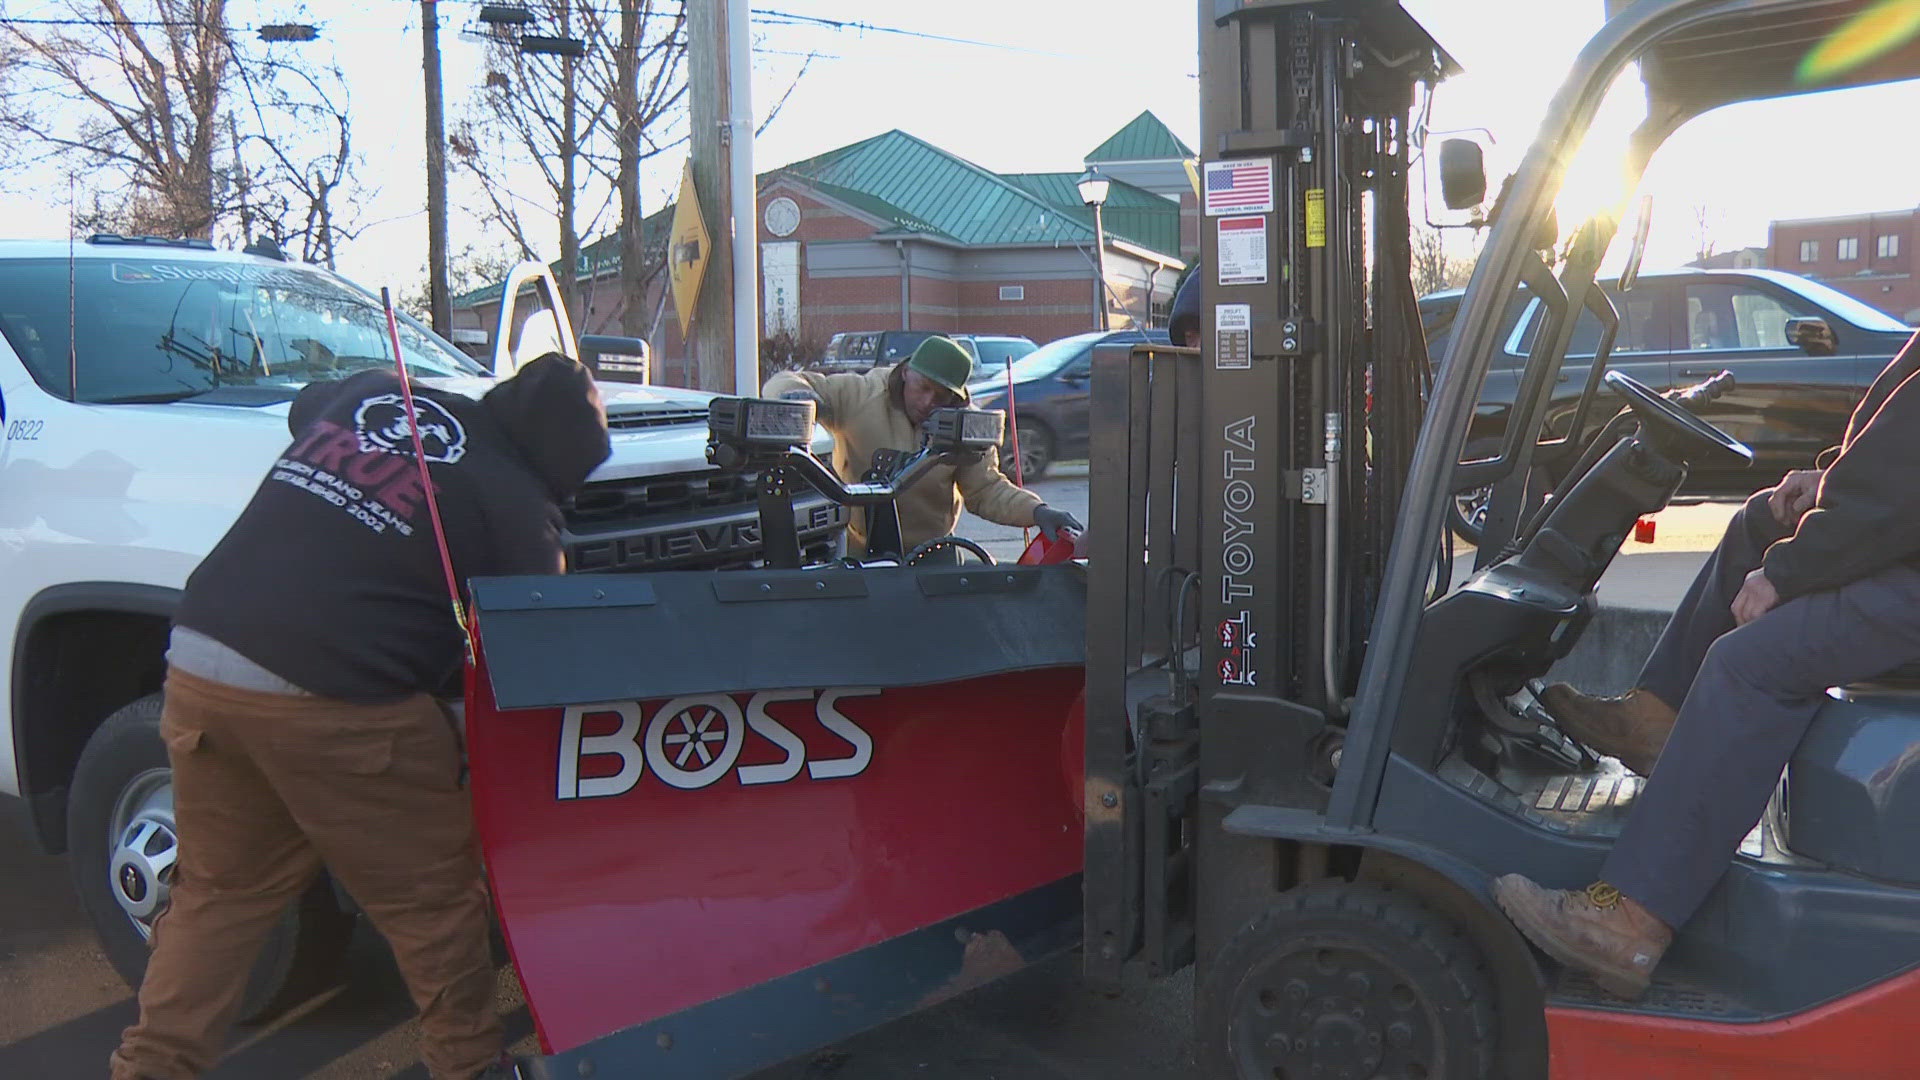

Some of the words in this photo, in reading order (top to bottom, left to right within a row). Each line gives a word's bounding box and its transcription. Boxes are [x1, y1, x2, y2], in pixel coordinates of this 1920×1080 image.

[7, 420, 44, 440] 0822
[291, 421, 442, 519] TRUE
[313, 469, 364, 501] BRAND
[362, 500, 414, 537] JEANS
[346, 504, 386, 534] 2002
[572, 503, 843, 573] CHEVRET
[1222, 415, 1255, 603] TOYOTA
[556, 687, 882, 800] BOSS
